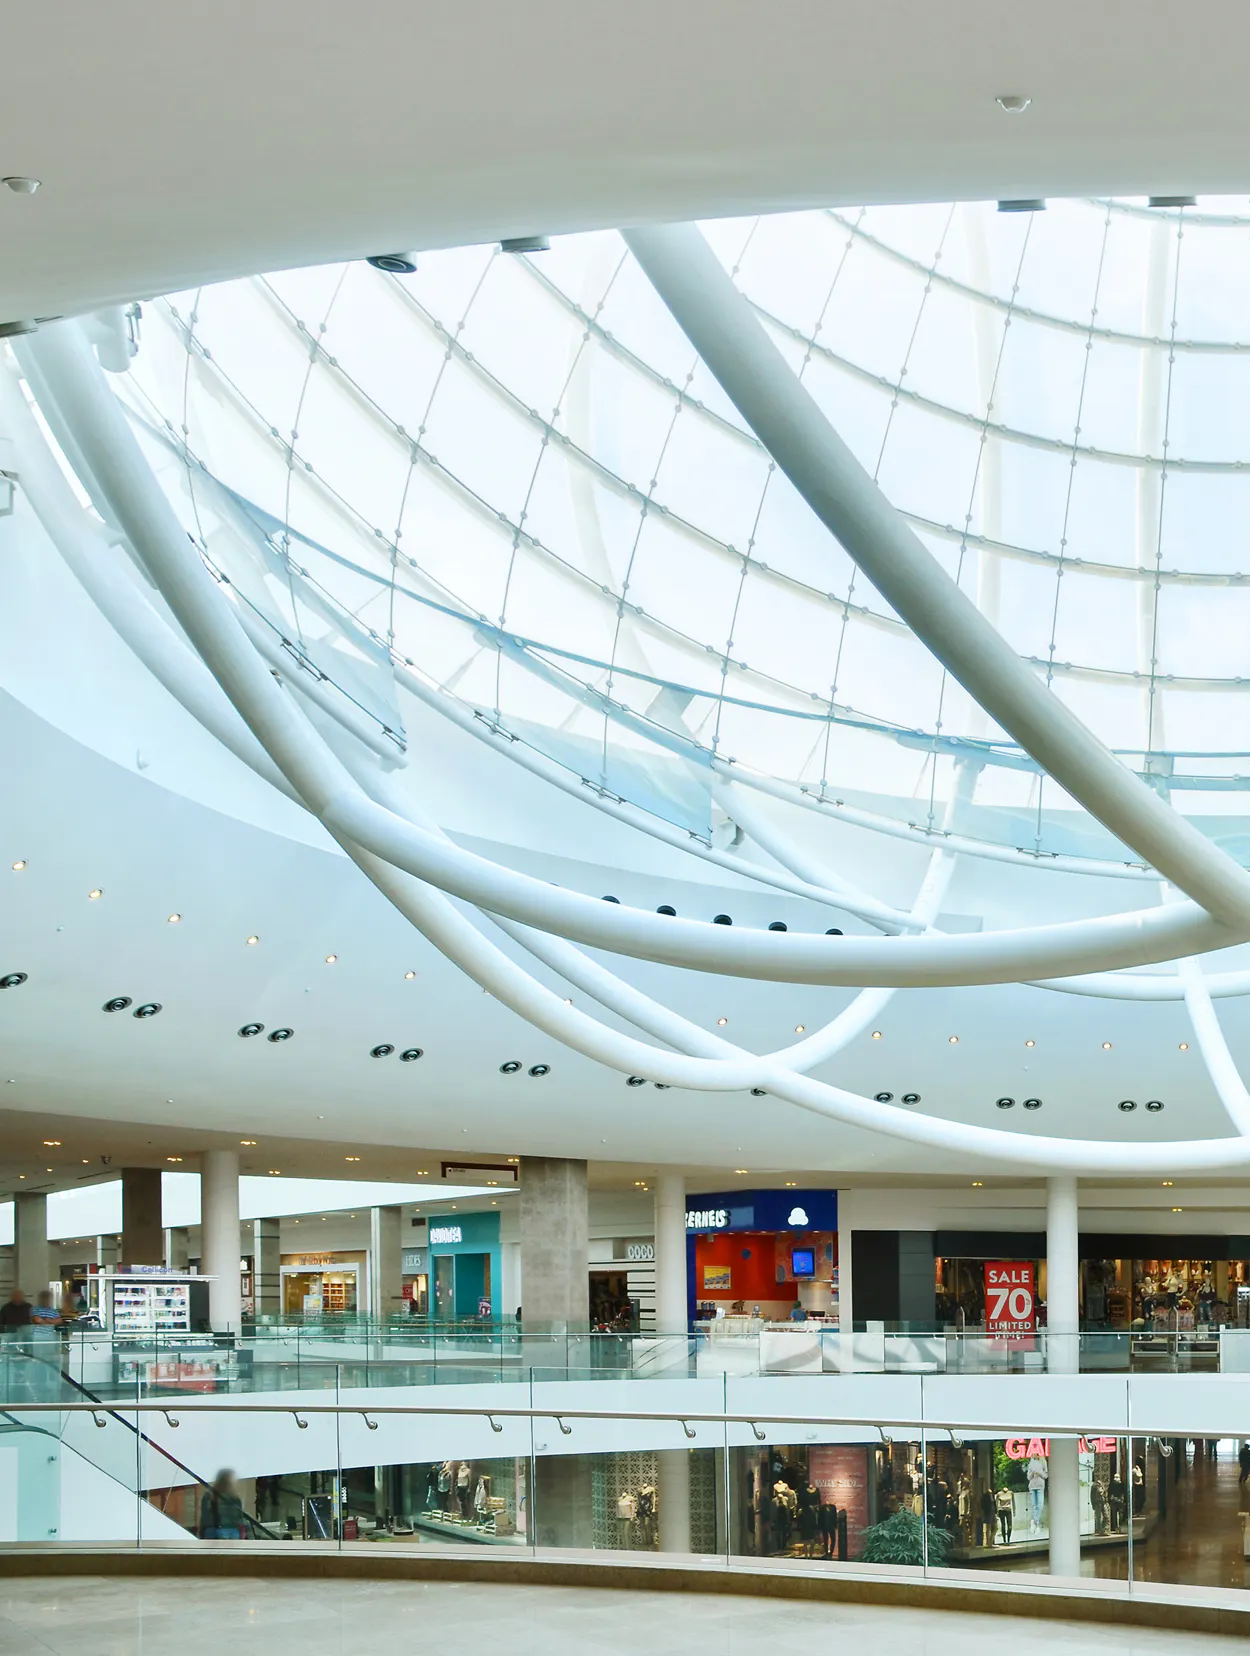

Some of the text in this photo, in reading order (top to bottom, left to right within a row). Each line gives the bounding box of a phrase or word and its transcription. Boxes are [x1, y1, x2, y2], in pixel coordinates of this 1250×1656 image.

[685, 1210, 728, 1228] ERNELS
[628, 1244, 653, 1259] COCO
[988, 1270, 1030, 1284] SALE
[987, 1287, 1032, 1320] 70
[989, 1321, 1031, 1330] LIMITED
[1005, 1437, 1117, 1460] GAGE
